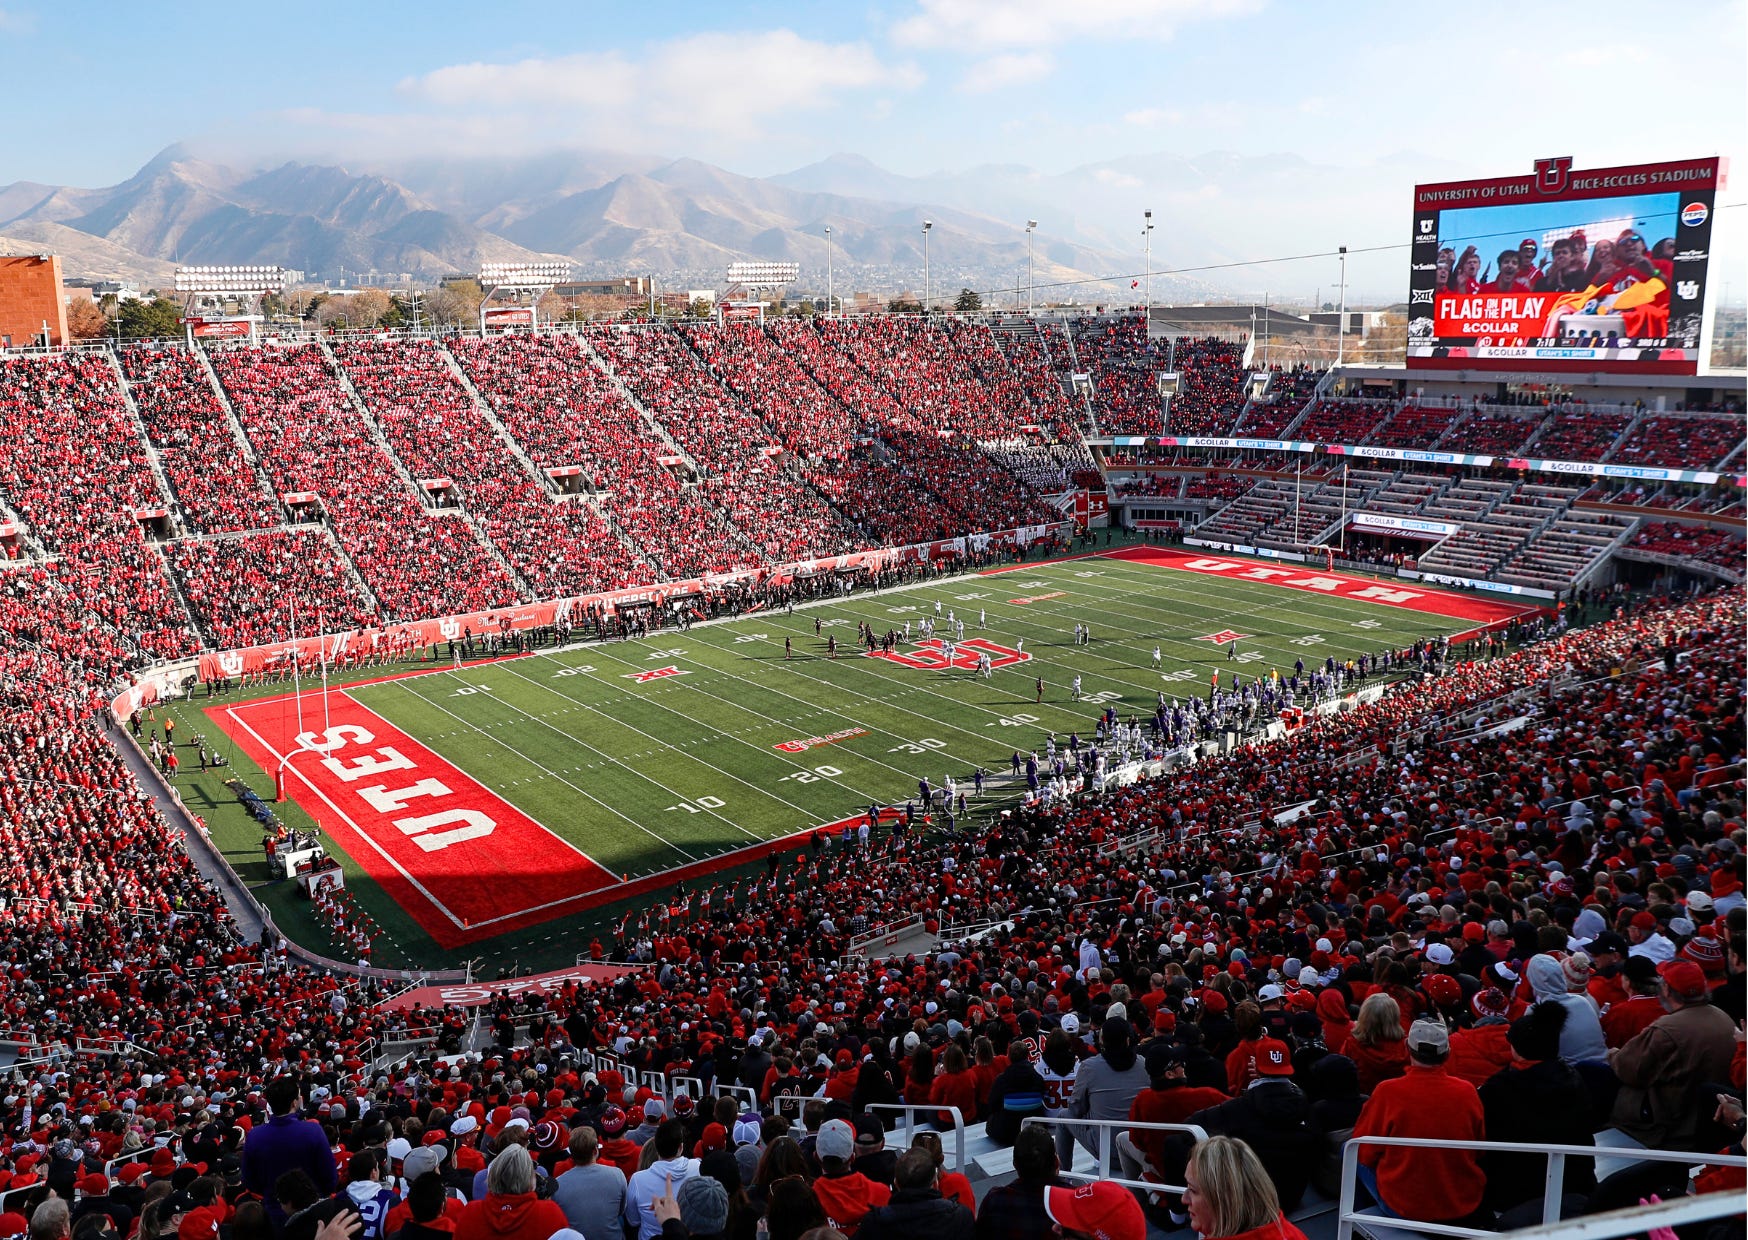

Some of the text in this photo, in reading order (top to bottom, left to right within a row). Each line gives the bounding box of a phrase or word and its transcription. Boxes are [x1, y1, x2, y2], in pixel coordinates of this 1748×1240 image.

[1572, 168, 1712, 190] RICE-ECCLES STADIUM
[1419, 184, 1529, 203] UNIVERSITY OF UTAH
[1440, 297, 1545, 320] FLAG ON PLAY
[1484, 308, 1499, 319] THE
[1462, 322, 1519, 333] &COLLAR
[1488, 349, 1527, 357] &COLLAR
[1361, 449, 1396, 457] &COLLAR
[1551, 463, 1594, 472] &COLLAR
[1365, 517, 1395, 525] &COLLAR
[1384, 528, 1416, 536] UTAH
[1016, 581, 1042, 589] 20
[1183, 559, 1424, 603] UTAH
[954, 592, 984, 601] 30
[887, 605, 917, 614] 40
[818, 618, 851, 628] 50
[1351, 620, 1382, 630] 10
[736, 633, 768, 643] 40
[1289, 637, 1325, 647] 20
[650, 648, 689, 659] 30
[1236, 652, 1265, 664] 30
[557, 665, 598, 677] 20
[1161, 669, 1197, 682] 40
[455, 684, 493, 696] 10
[1080, 691, 1123, 704] 50
[999, 713, 1040, 727] 40
[898, 738, 947, 754] 30
[792, 765, 843, 784] 20
[295, 723, 497, 853] UTES
[678, 796, 727, 814] 10
